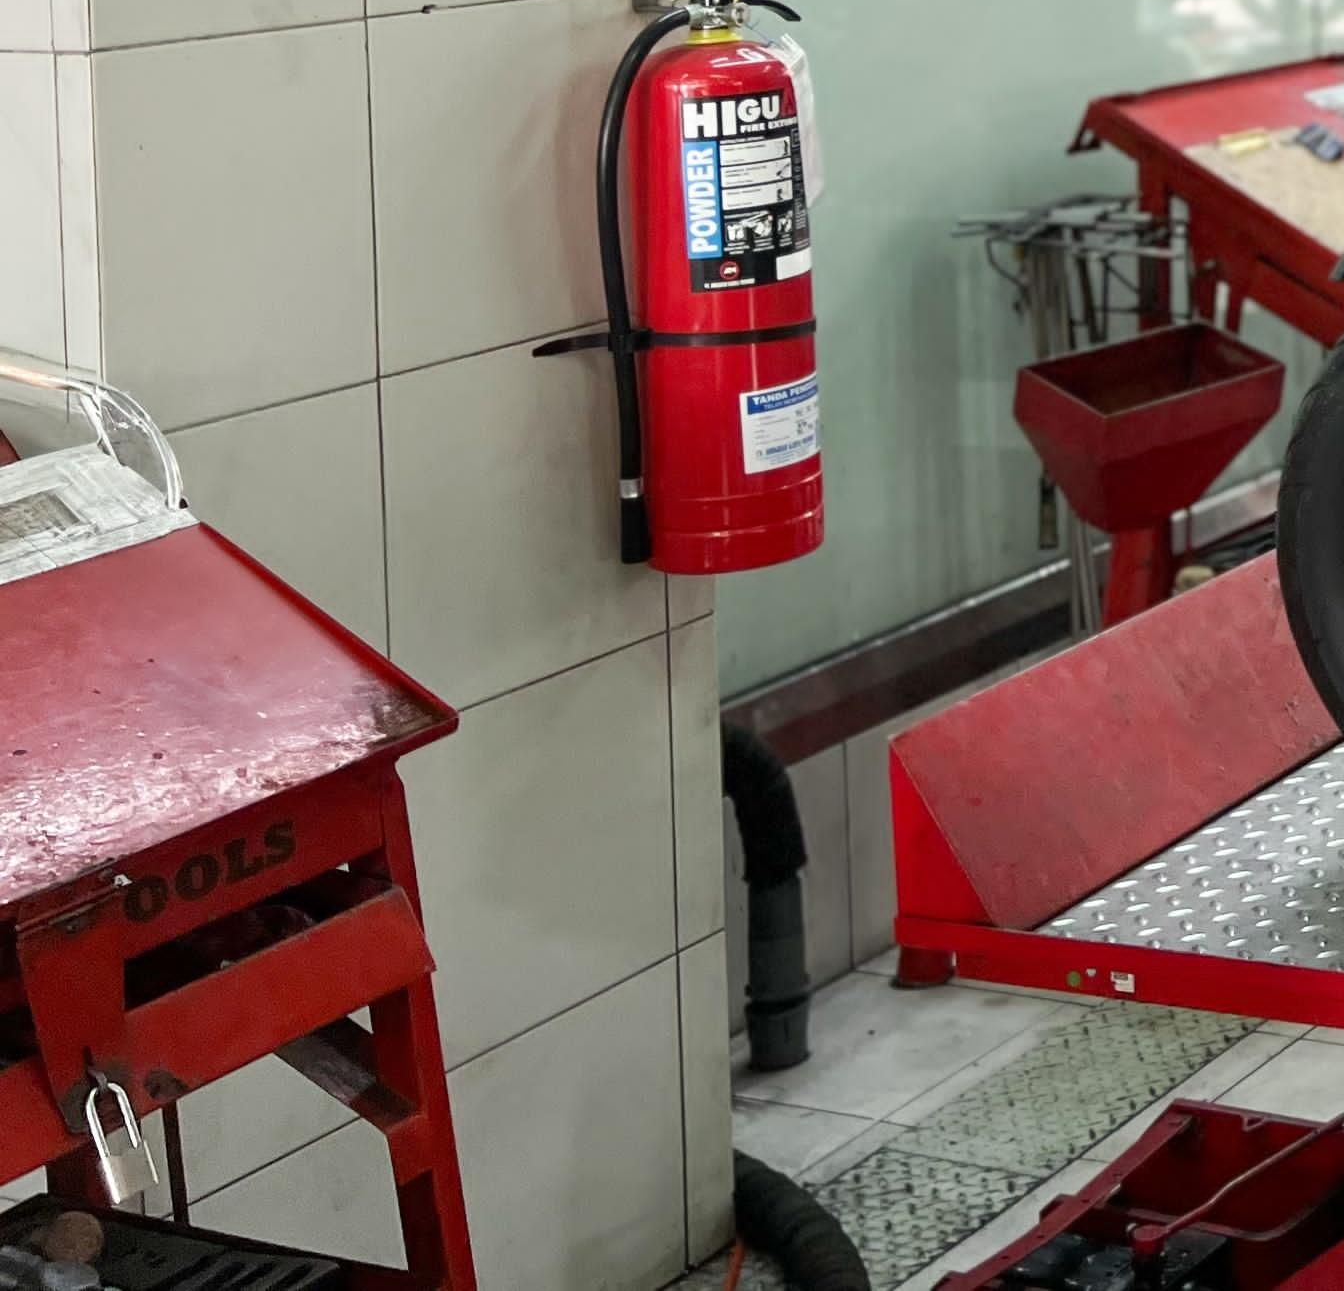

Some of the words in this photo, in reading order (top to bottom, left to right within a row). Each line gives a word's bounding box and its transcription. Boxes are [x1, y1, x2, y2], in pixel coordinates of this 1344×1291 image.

[682, 90, 798, 139] HIGUA
[686, 148, 719, 254] POWDER
[752, 390, 788, 406] TANDA
[123, 818, 297, 924] OOLS
